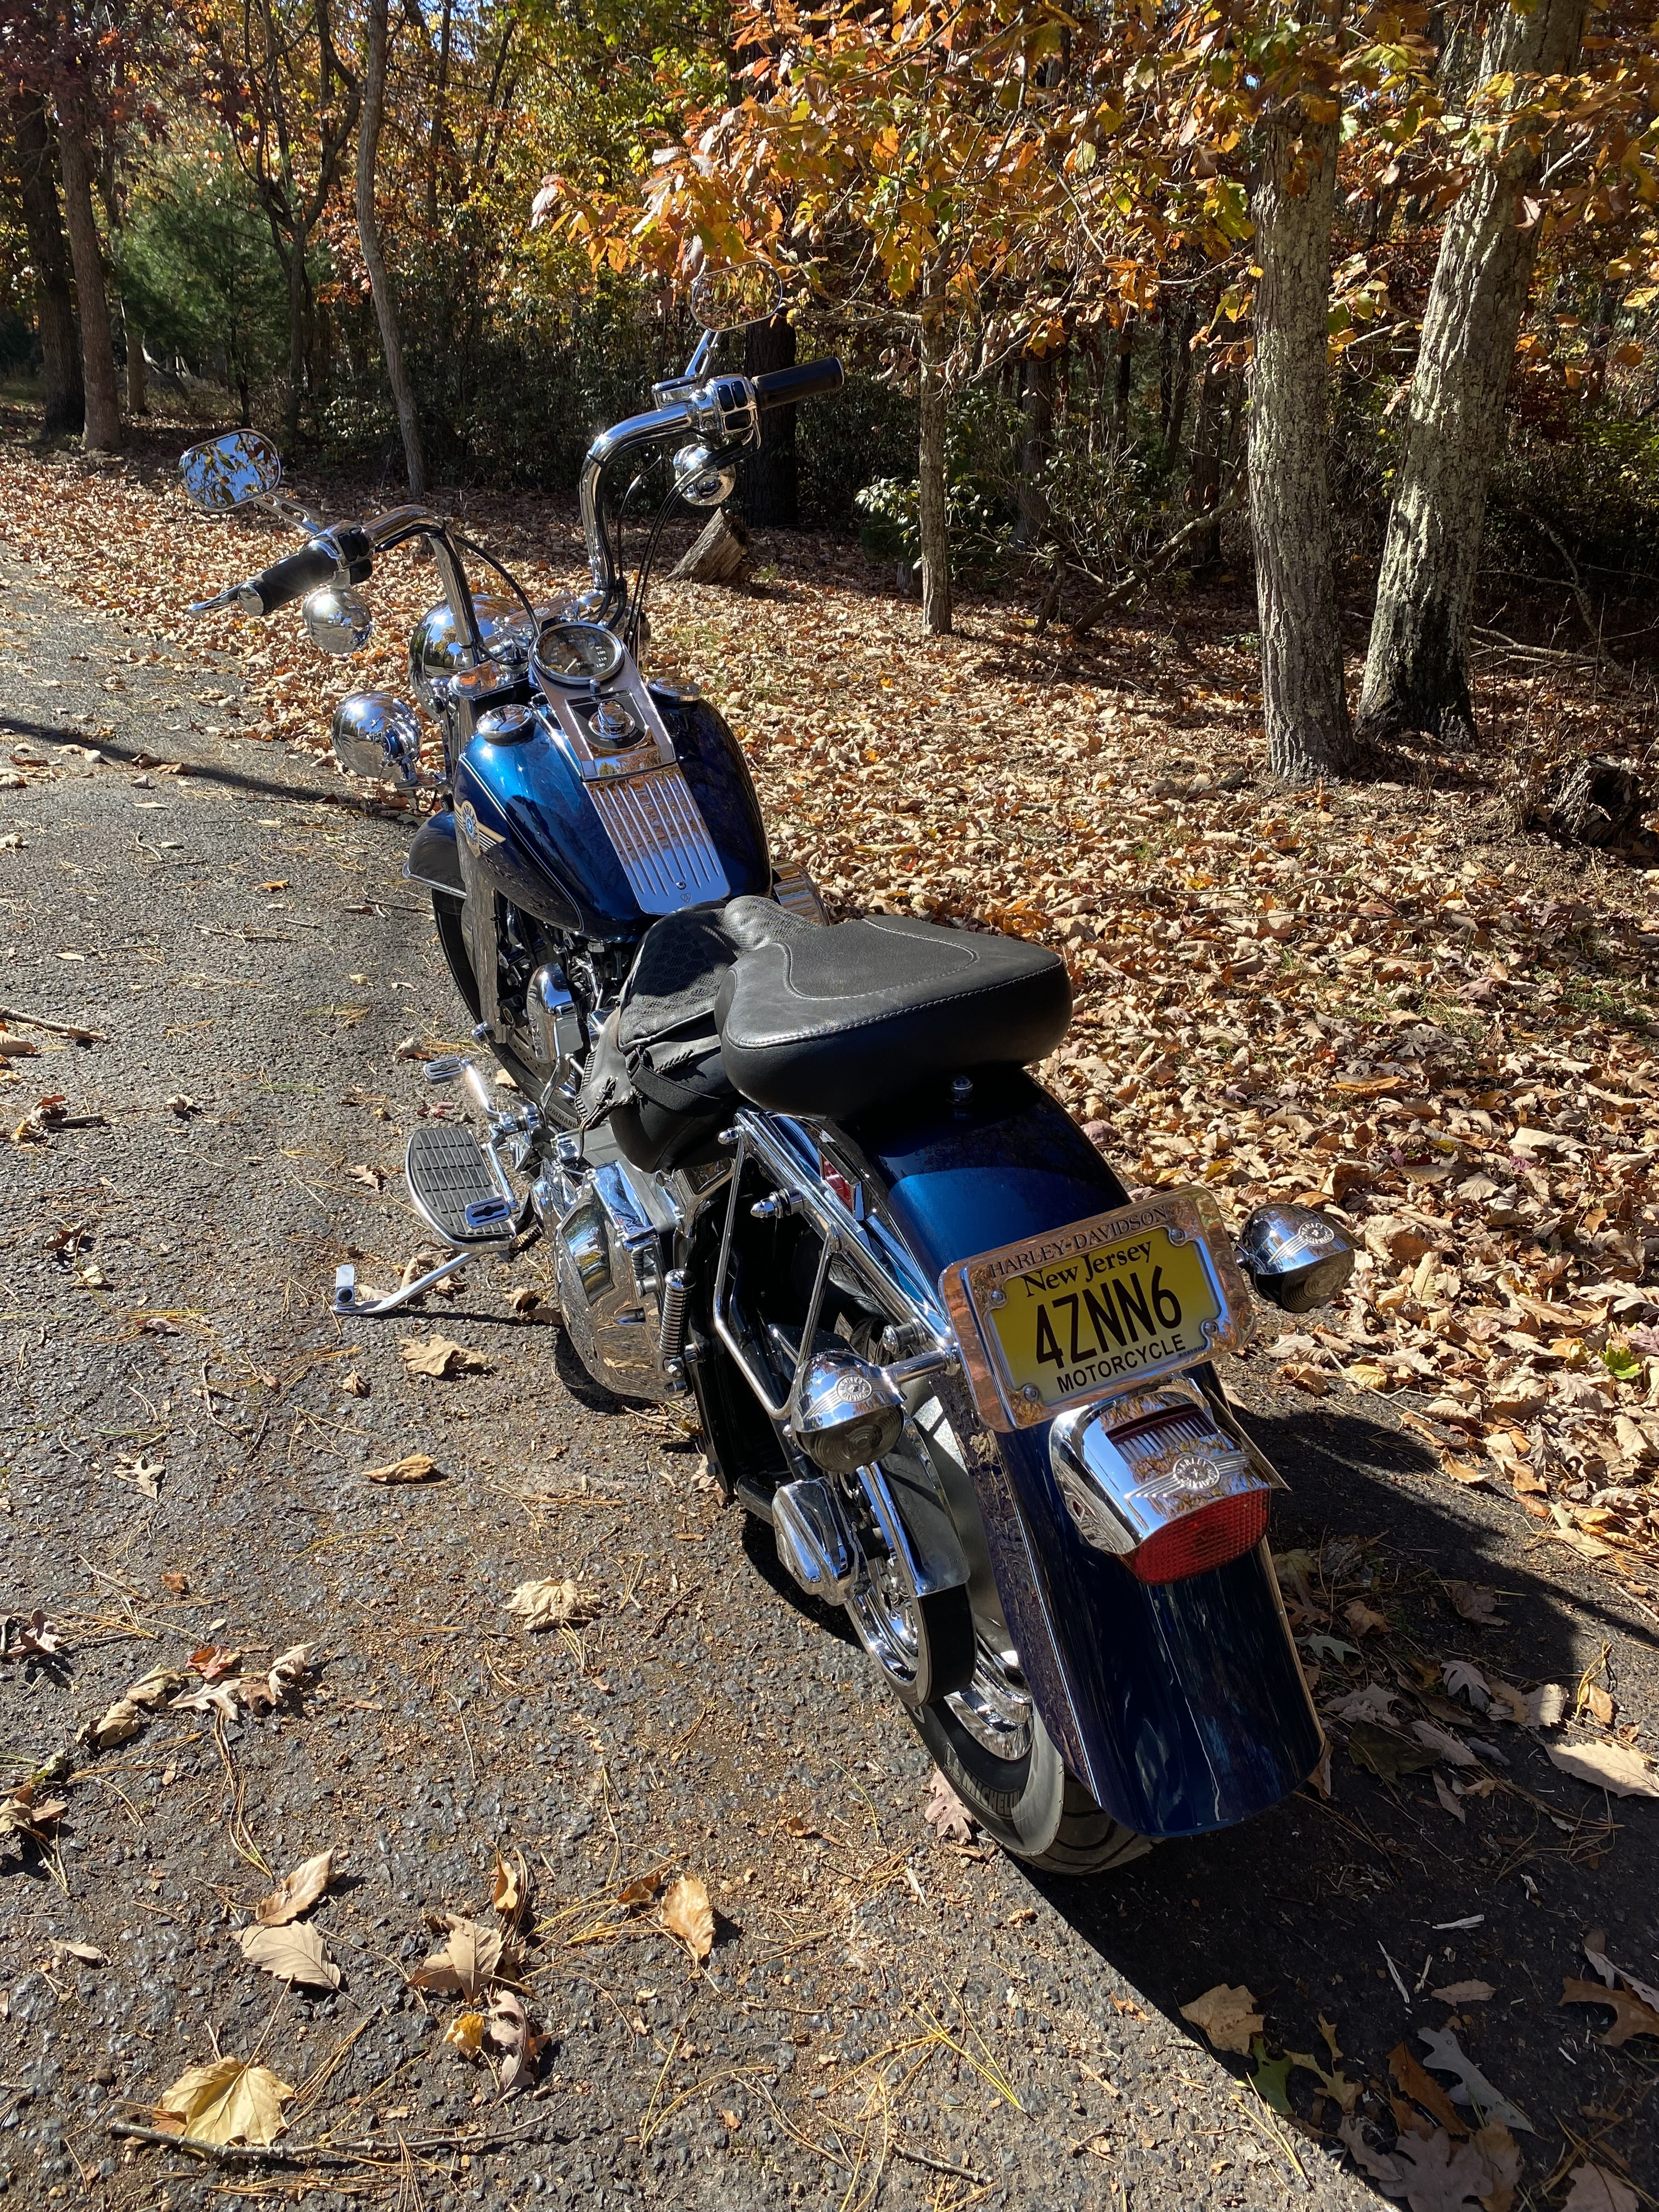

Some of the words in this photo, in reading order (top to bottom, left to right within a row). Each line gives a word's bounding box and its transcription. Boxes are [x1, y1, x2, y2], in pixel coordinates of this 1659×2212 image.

[548, 1105, 580, 1128] OMMAND
[989, 1205, 1168, 1278] HARLEY-DAVIDSON
[1020, 1265, 1078, 1297] New
[1081, 1241, 1152, 1283] Jersey
[1036, 1265, 1182, 1369] 4ZNN6
[1057, 1334, 1186, 1393] MOTORCYCLE
[962, 1769, 1020, 1816] MICHELIN
